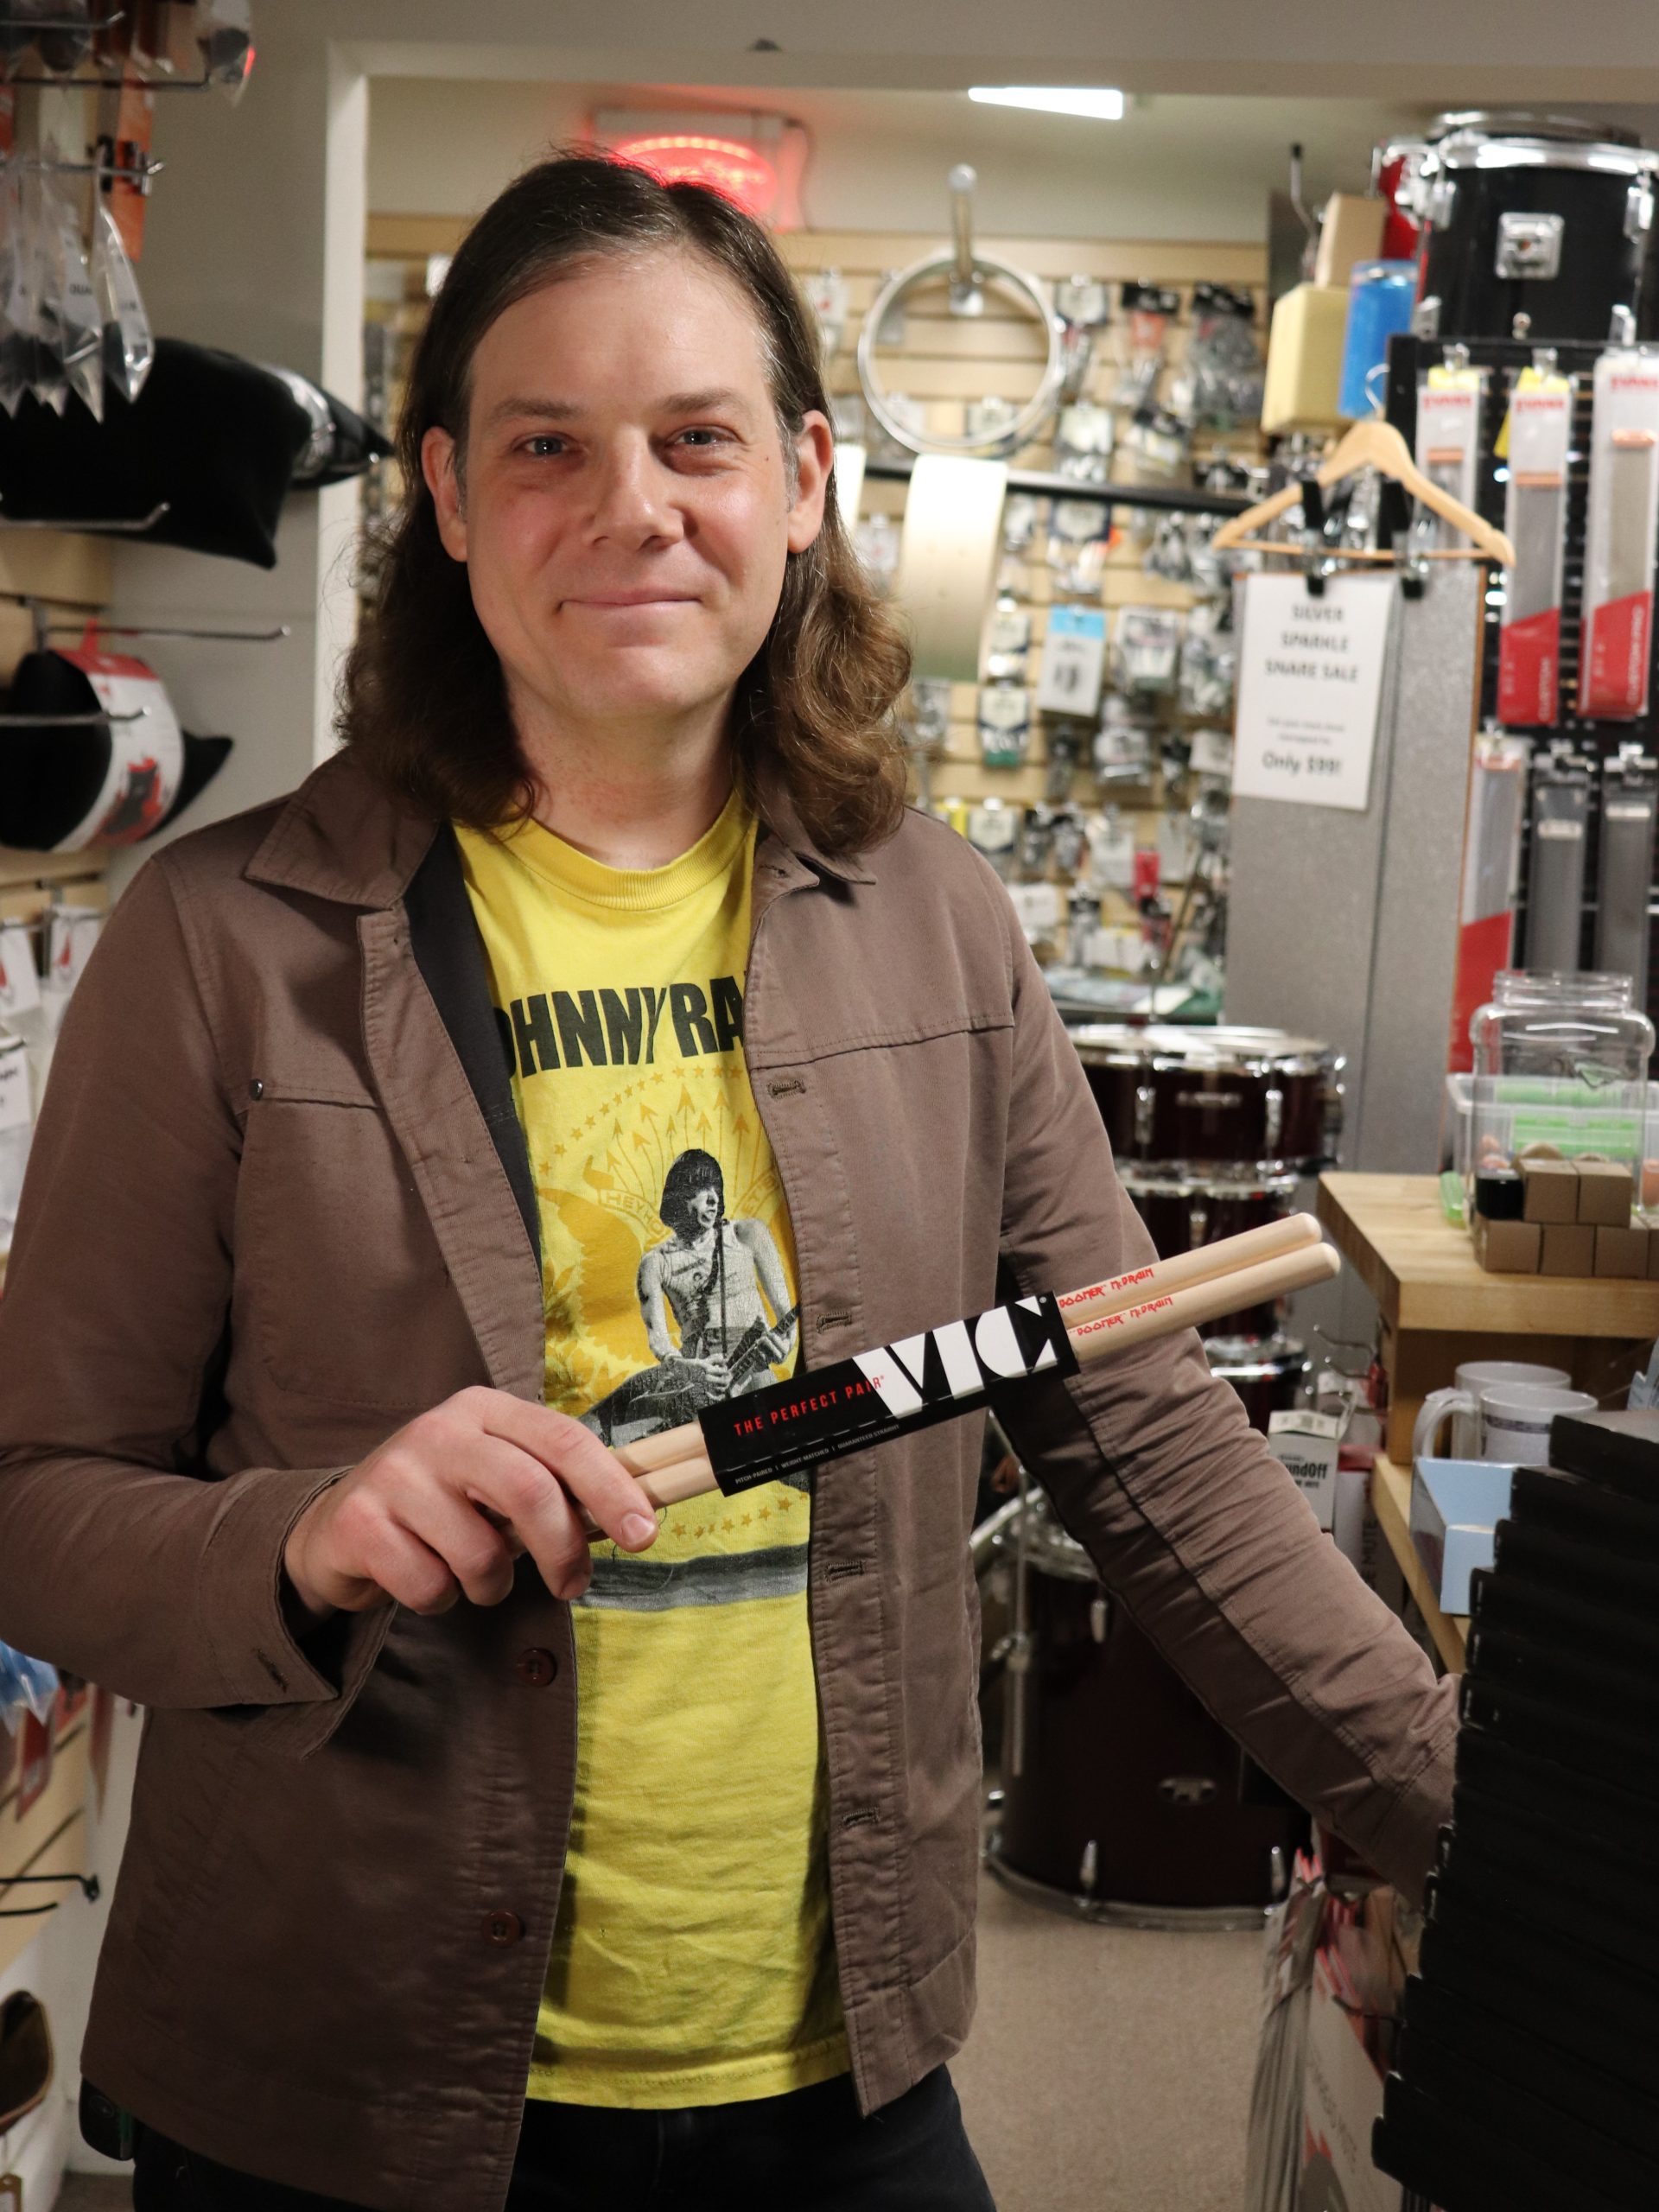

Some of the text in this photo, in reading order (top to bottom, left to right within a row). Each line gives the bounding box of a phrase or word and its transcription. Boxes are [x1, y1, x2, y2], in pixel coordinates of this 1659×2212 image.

[1292, 606, 1343, 624] SILVER
[1281, 632, 1349, 653] SPARKLE
[1265, 659, 1359, 683] SNARE SALE
[1262, 751, 1300, 778] Only
[607, 1192, 645, 1213] HEY
[734, 1417, 763, 1436] THE
[771, 1391, 838, 1424] PERFECT
[837, 1433, 873, 1449] GUARANTEED
[874, 1424, 899, 1439] STRAIGHT
